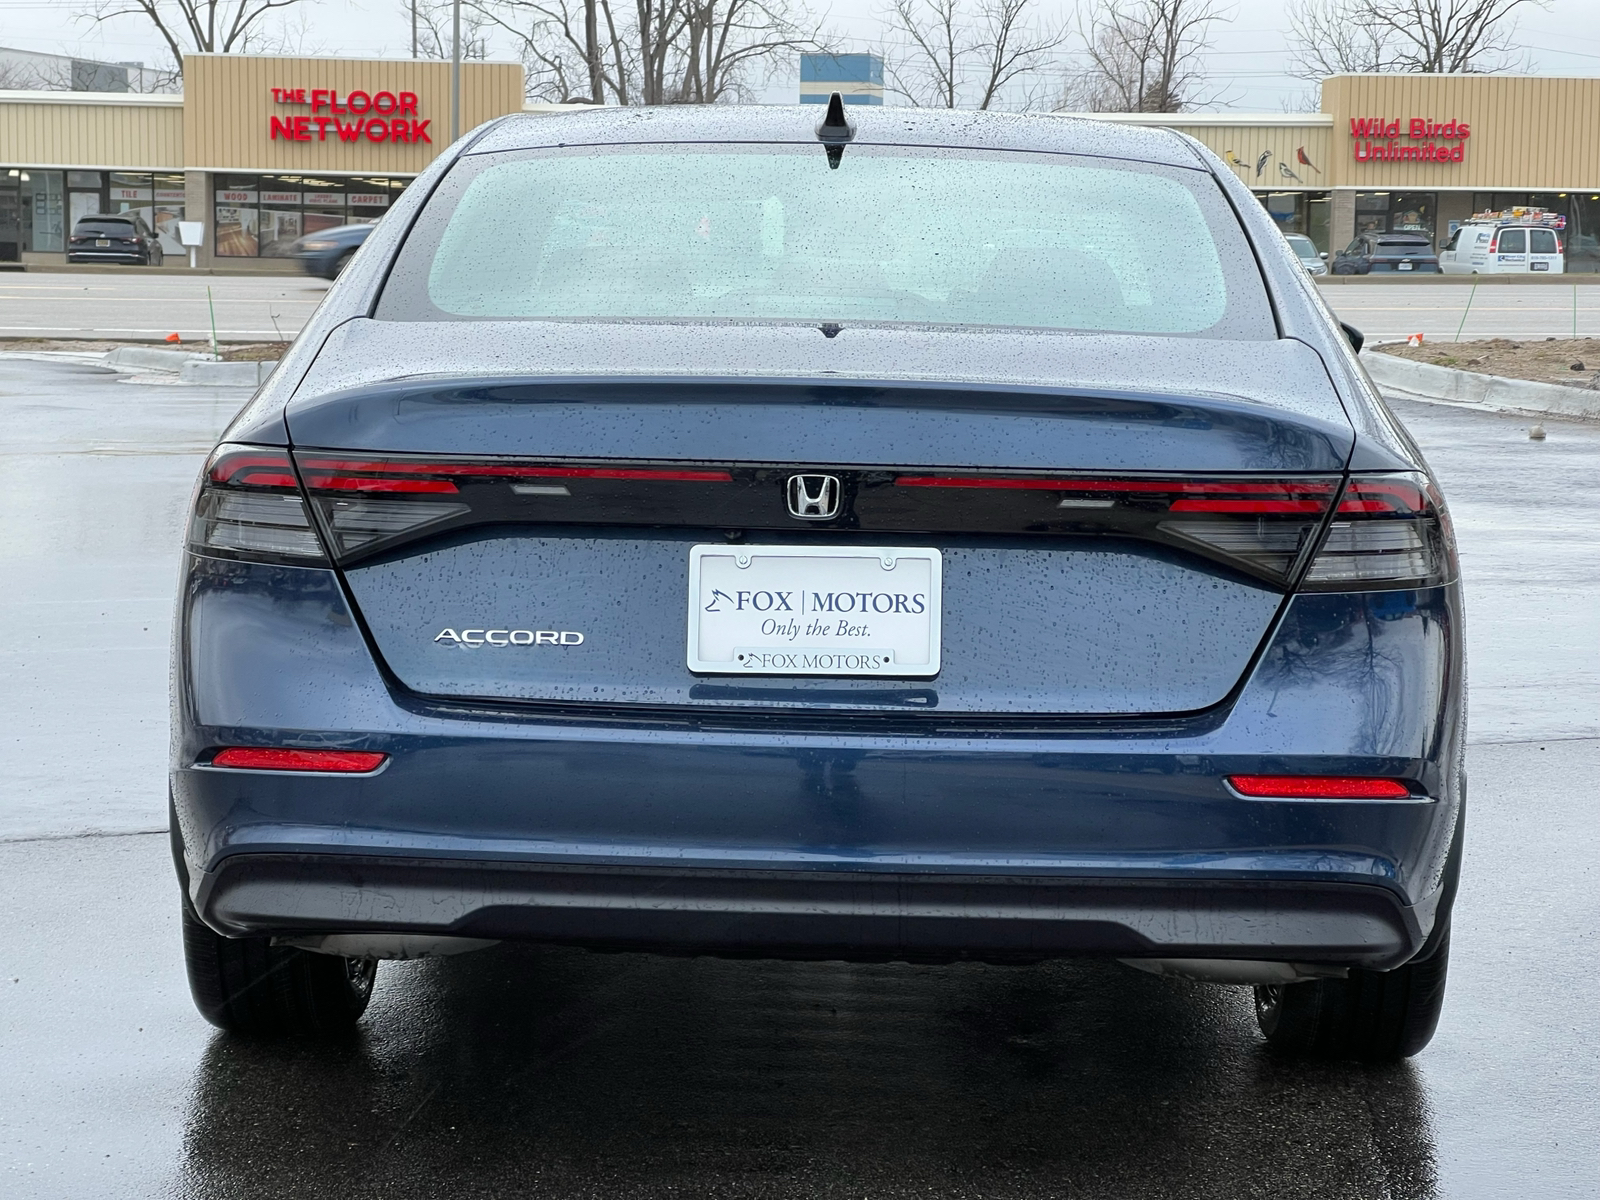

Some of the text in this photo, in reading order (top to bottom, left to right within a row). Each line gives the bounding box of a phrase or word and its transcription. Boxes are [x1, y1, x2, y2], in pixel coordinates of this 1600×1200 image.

[271, 88, 418, 116] THE FLOOR
[270, 115, 432, 144] NETWORK
[1350, 117, 1471, 140] Wild Birds
[1354, 141, 1465, 163] Unlimited
[121, 190, 138, 199] TILE
[223, 192, 248, 201] WOOD
[263, 194, 297, 202] LAMINATE
[351, 195, 383, 204] CARPET
[735, 590, 925, 614] FOX MOTORS
[434, 628, 584, 646] ACCORD
[761, 618, 871, 641] Only the Best.
[761, 653, 881, 670] FOX MOTORS
